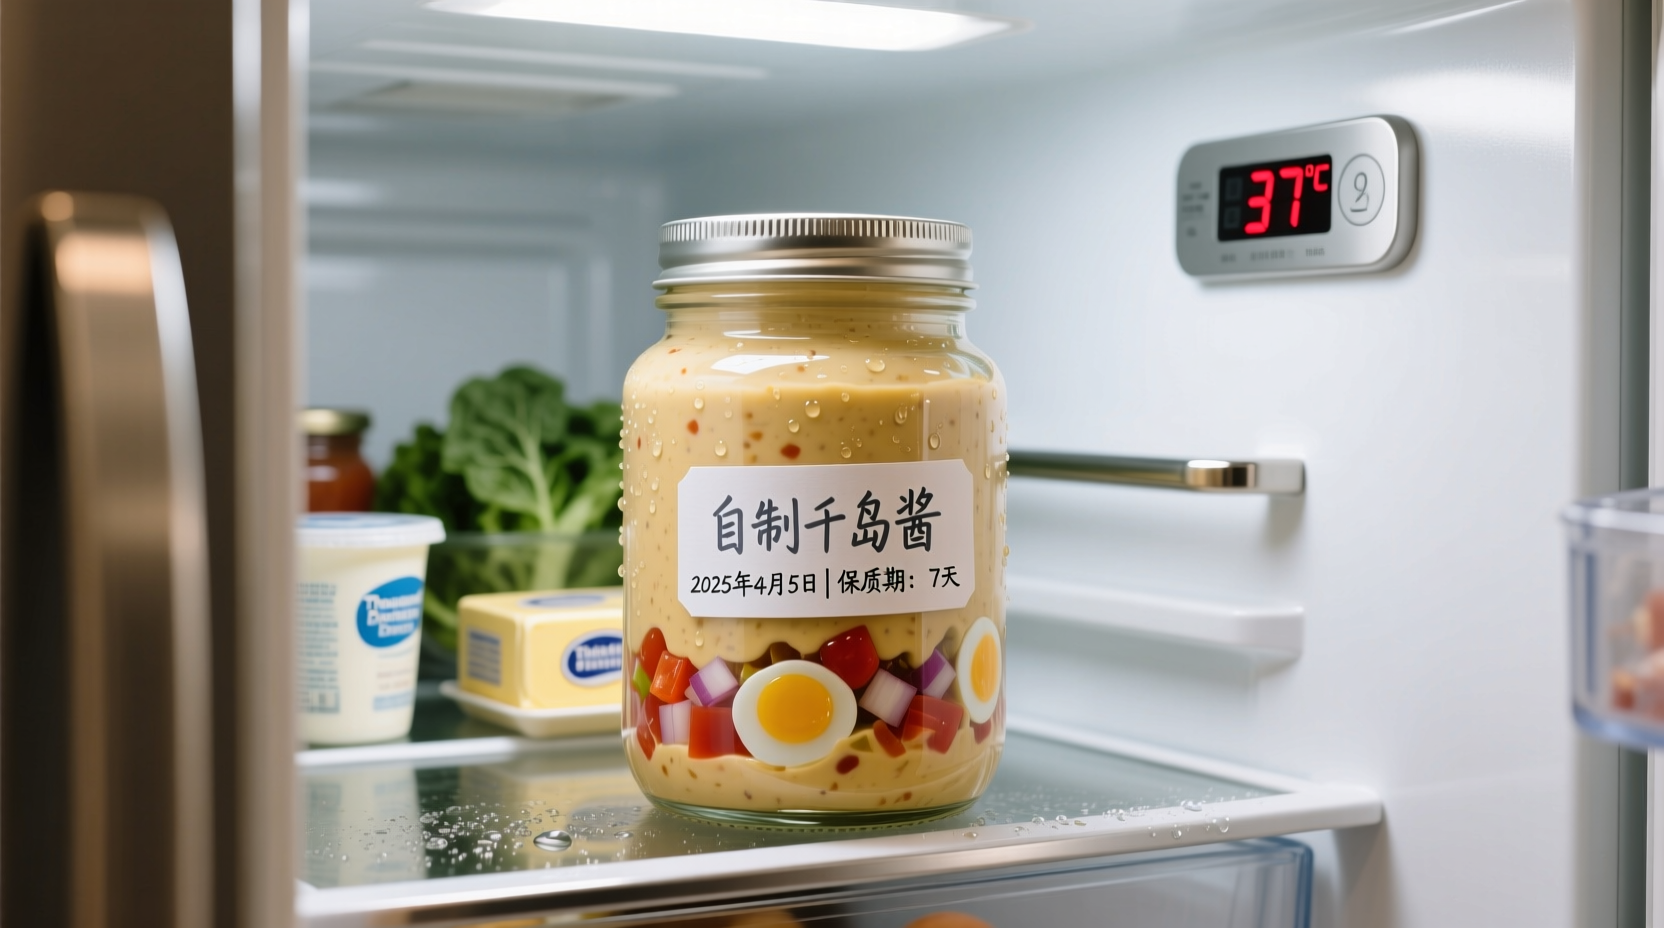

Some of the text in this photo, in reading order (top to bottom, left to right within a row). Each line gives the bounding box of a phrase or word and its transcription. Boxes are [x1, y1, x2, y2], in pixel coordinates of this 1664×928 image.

[712, 486, 942, 555] 自制千岛酱
[690, 570, 816, 598] 2025年4月5日
